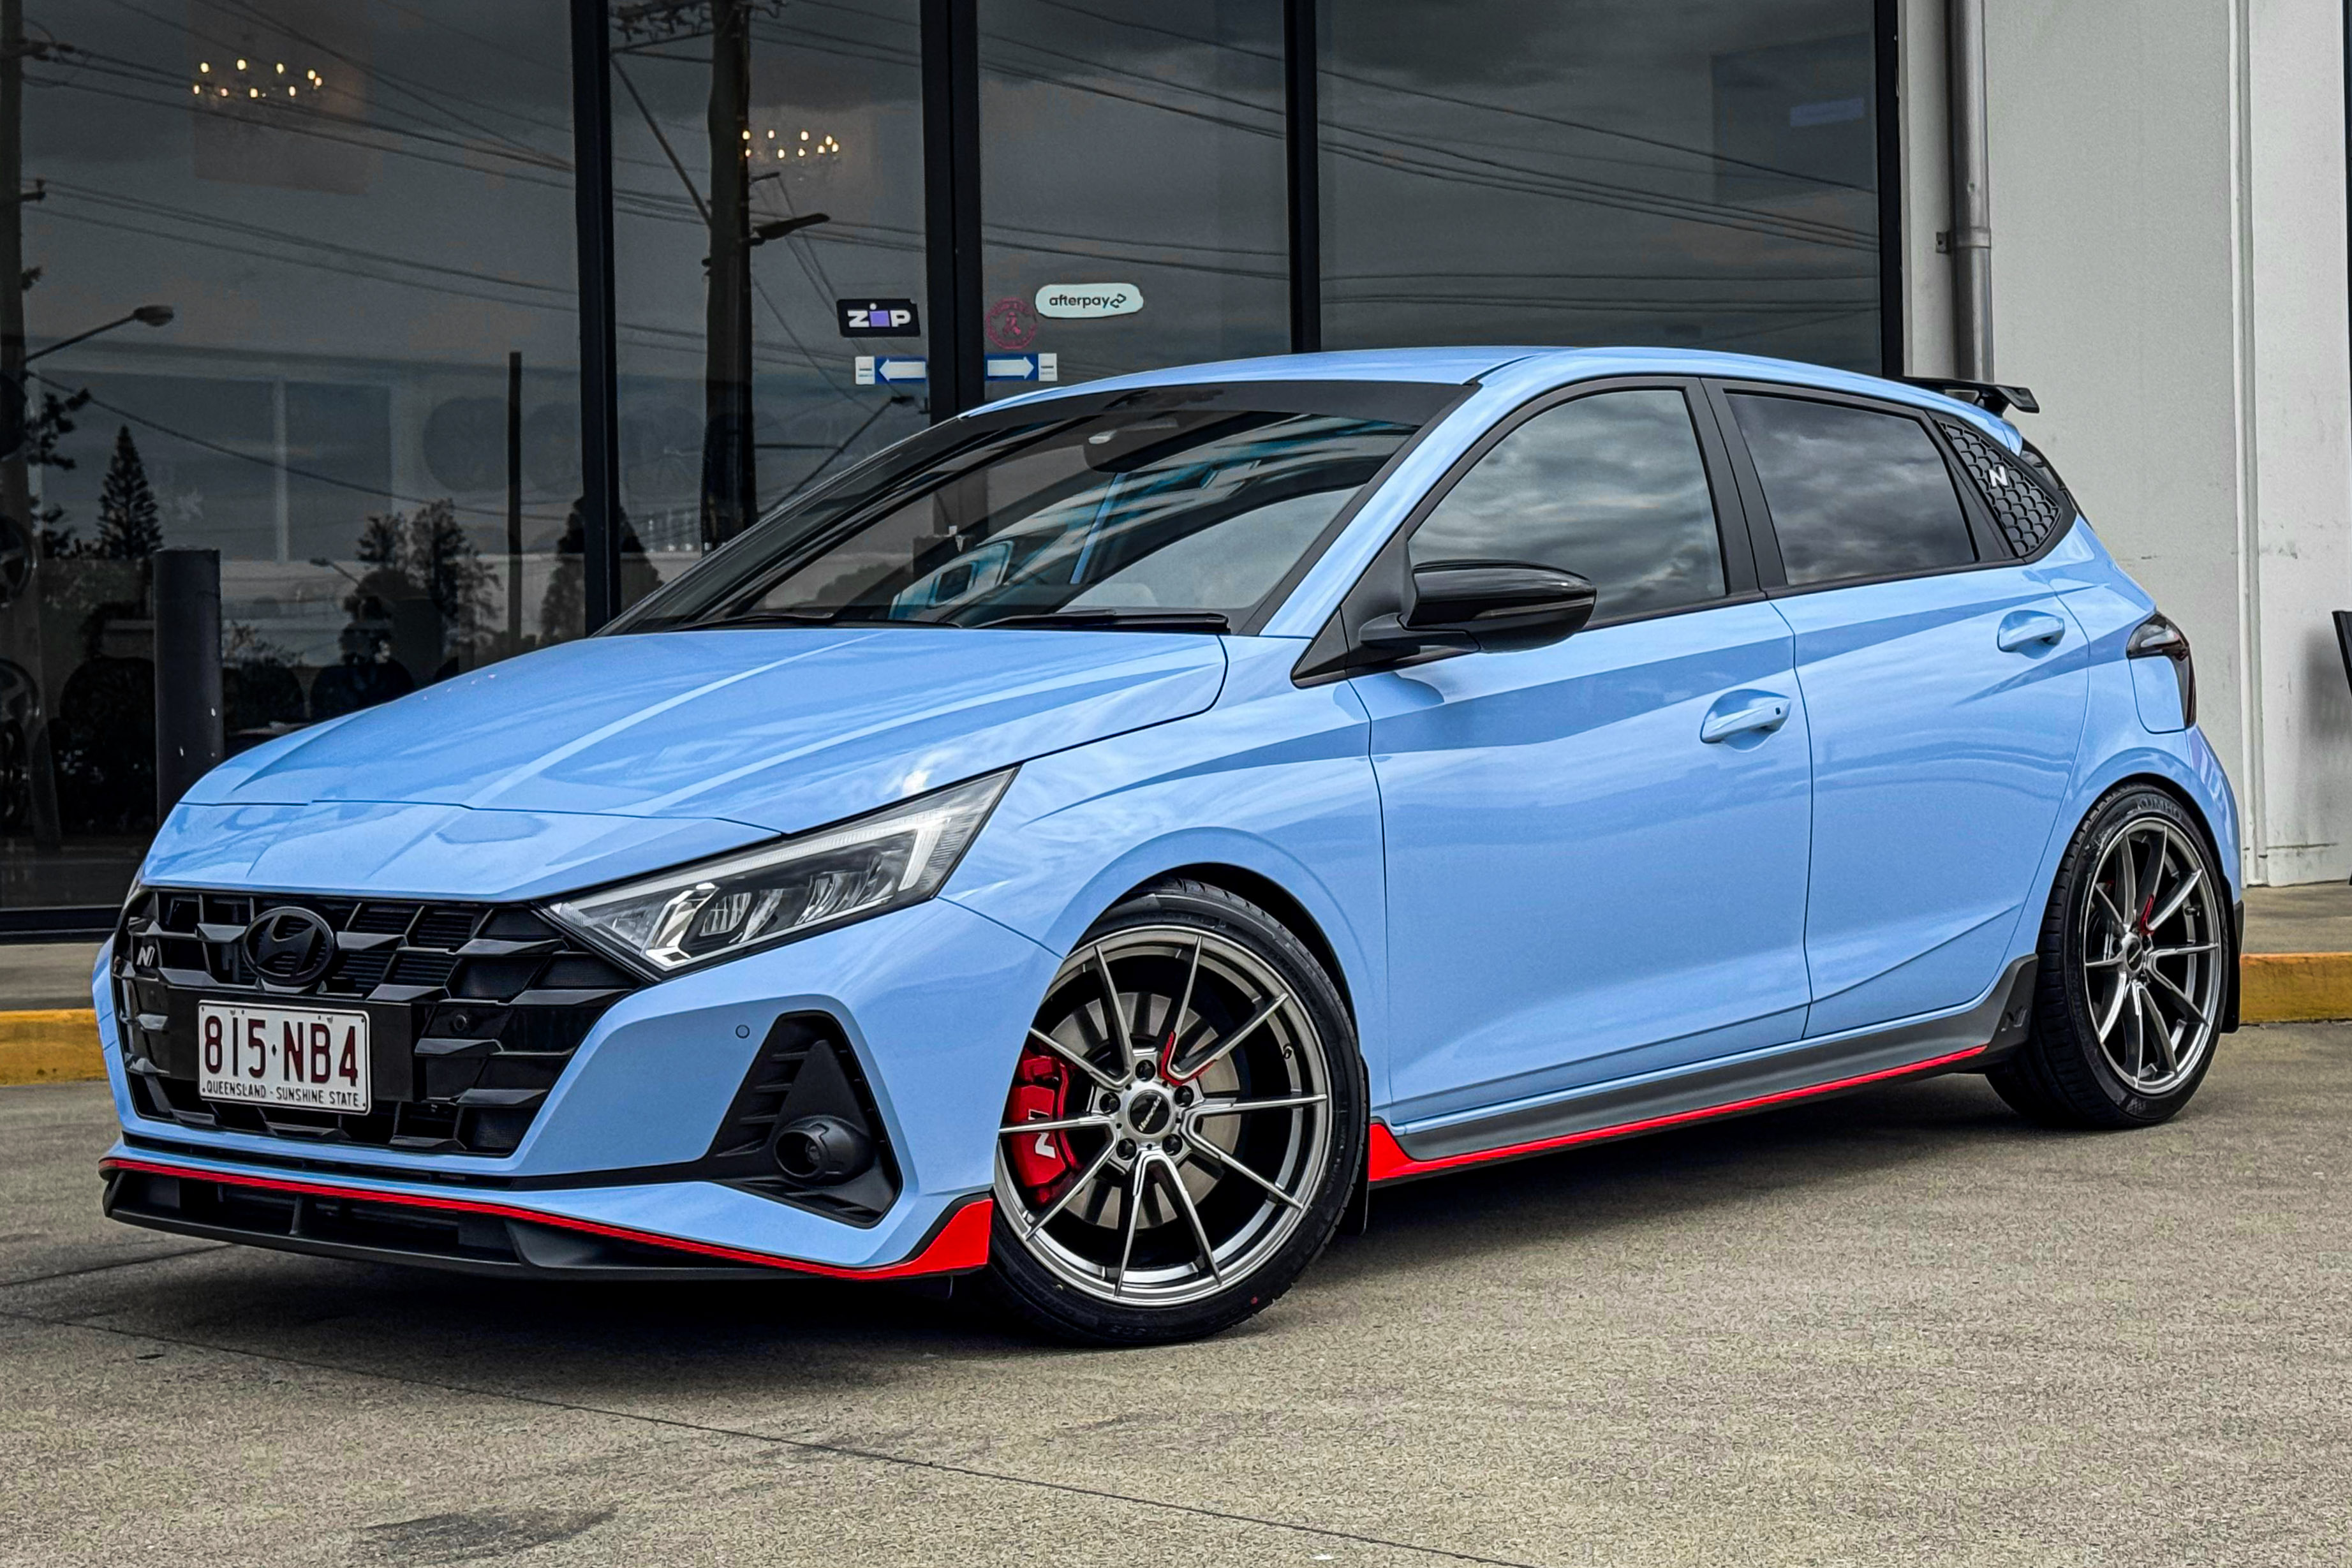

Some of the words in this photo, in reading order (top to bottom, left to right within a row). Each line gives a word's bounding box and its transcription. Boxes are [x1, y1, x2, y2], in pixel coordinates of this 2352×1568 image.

[1049, 294, 1111, 309] afterpay
[1988, 466, 2008, 487] N
[207, 1080, 267, 1098] QUEENSLAND
[276, 1086, 324, 1104] SUNSHINE
[329, 1090, 359, 1107] STATE
